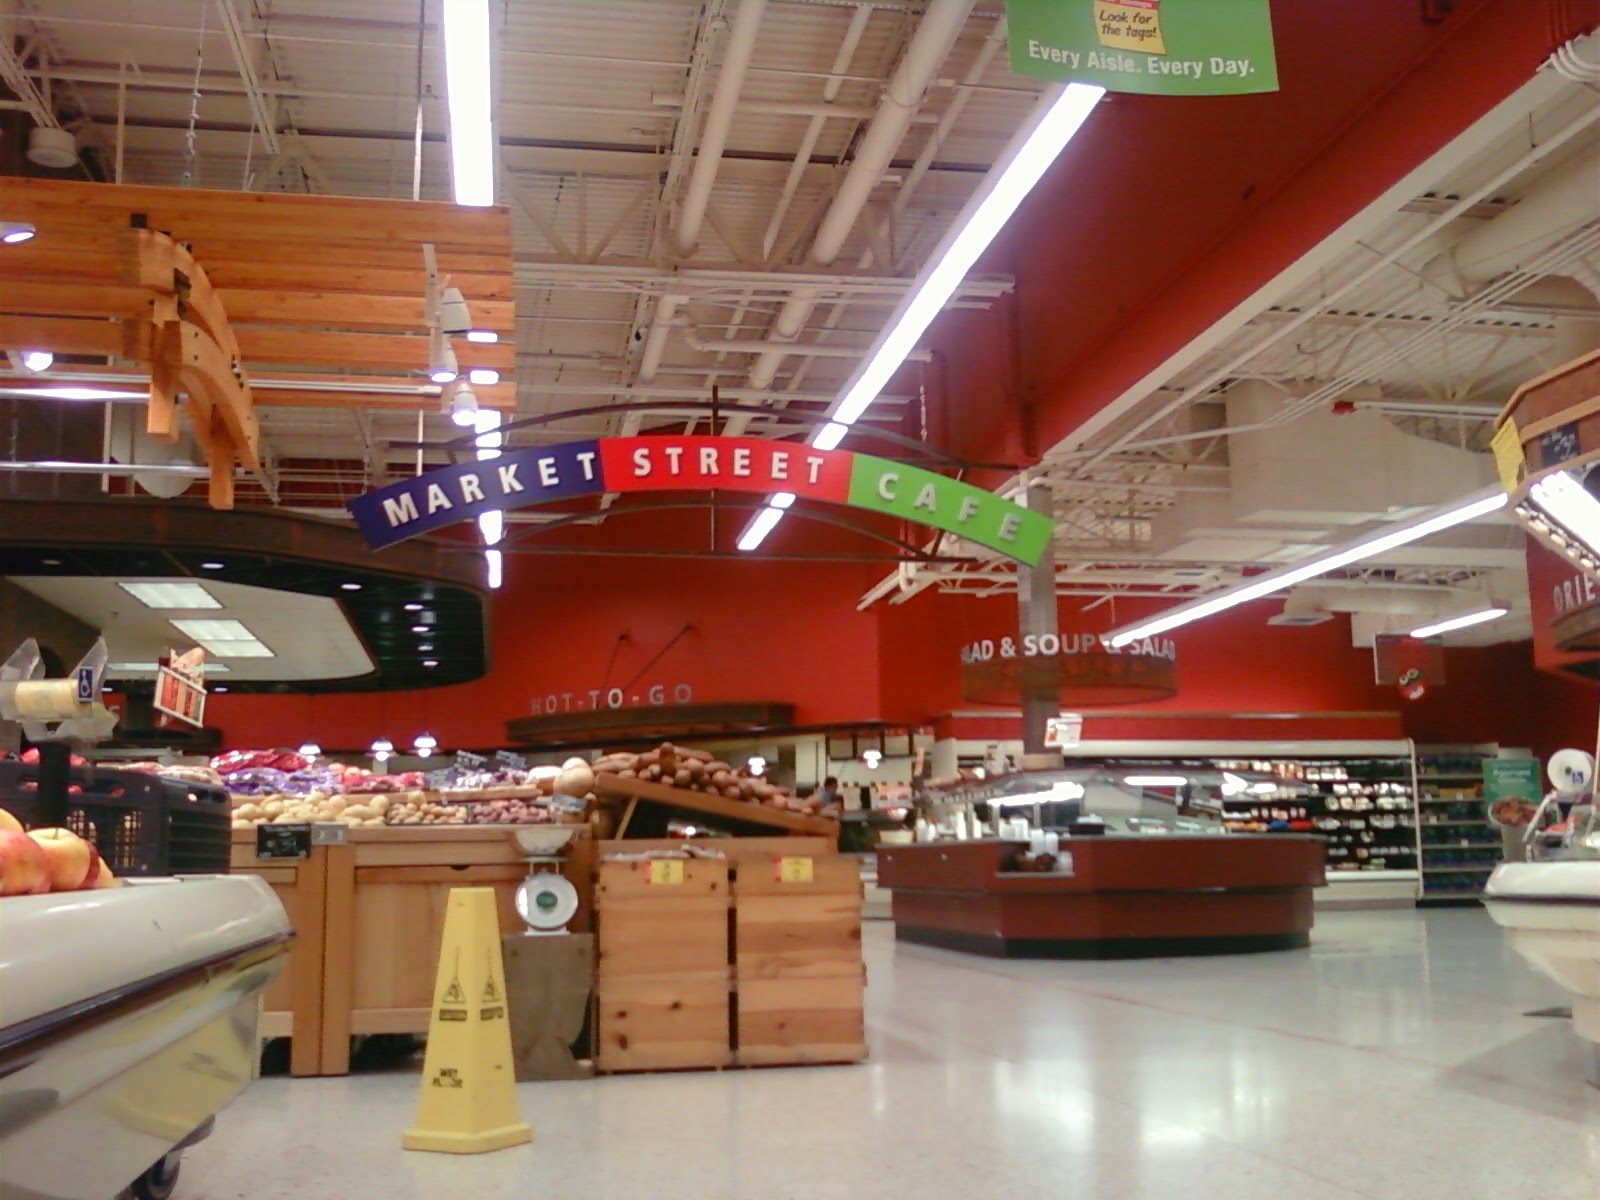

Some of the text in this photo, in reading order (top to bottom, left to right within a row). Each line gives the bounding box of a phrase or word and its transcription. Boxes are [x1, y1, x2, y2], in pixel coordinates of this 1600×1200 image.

[1099, 10, 1153, 24] Look for
[1102, 23, 1157, 41] the tags!
[1028, 39, 1255, 79] Every Aisle. Every Day.
[382, 446, 1022, 542] MARKET STREET CAFE
[1024, 633, 1094, 656] SOUP
